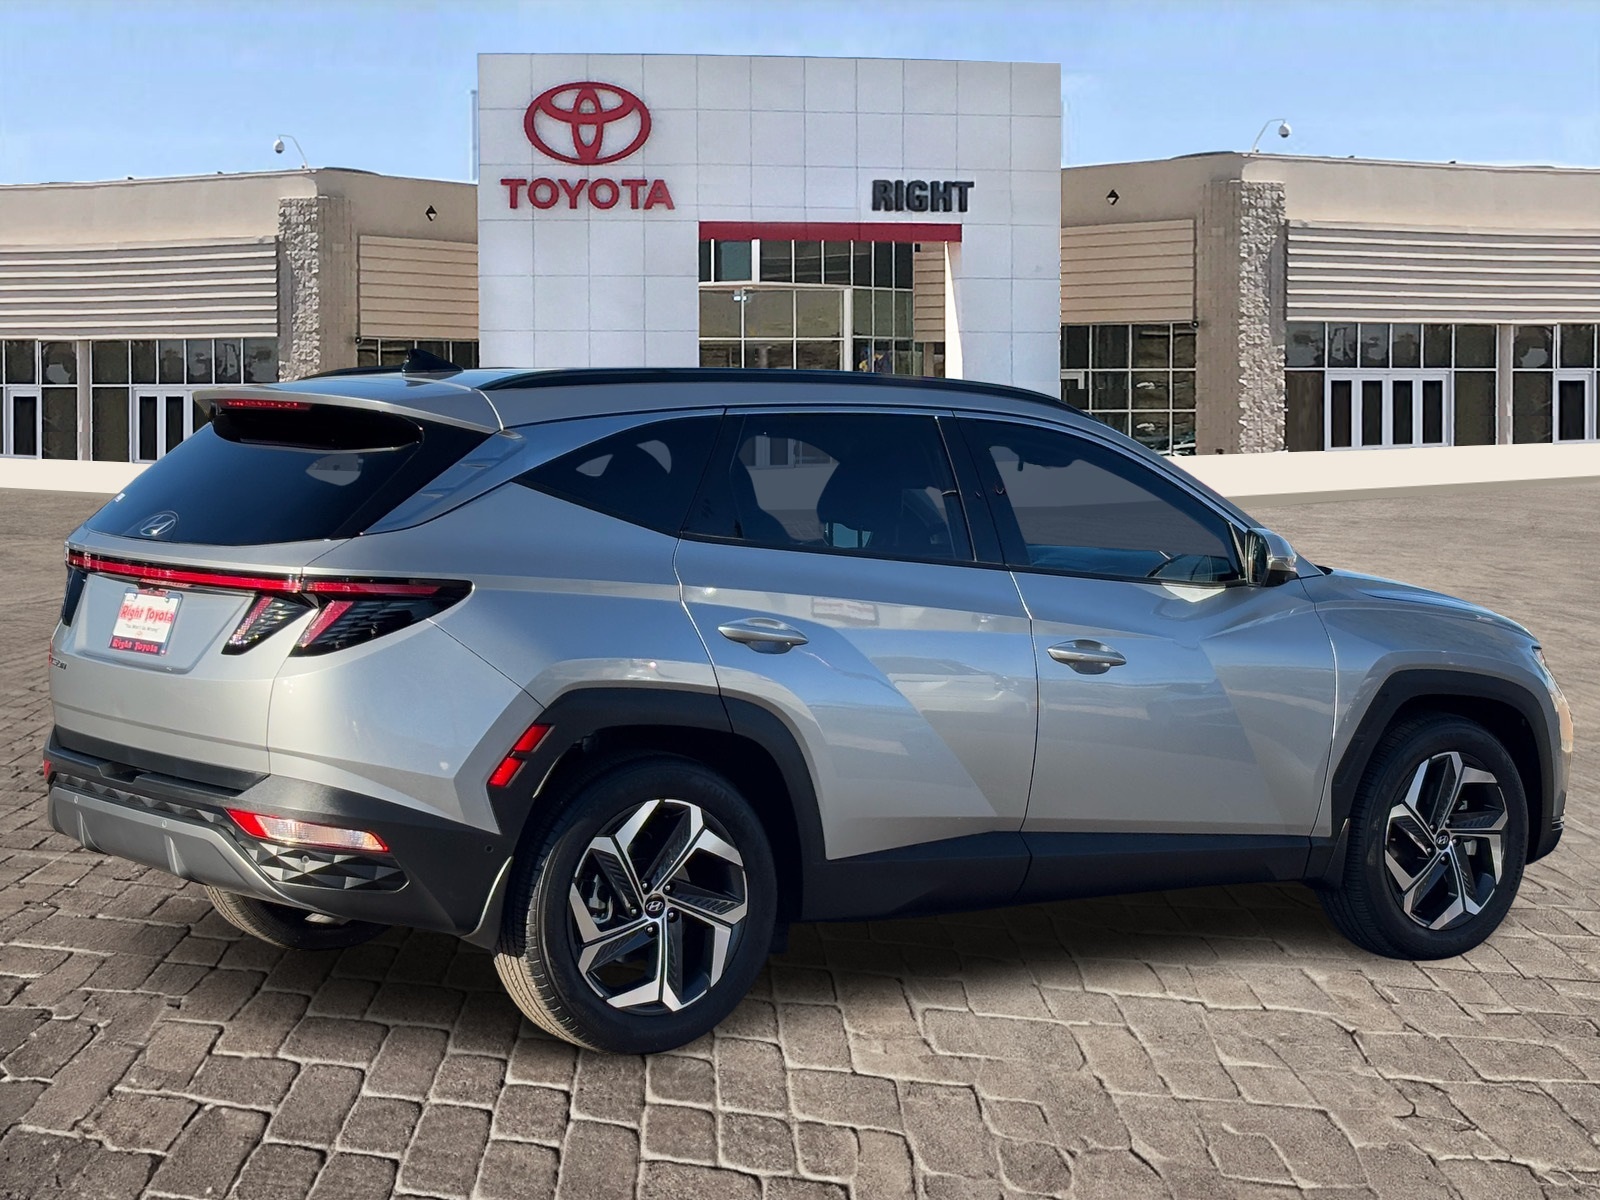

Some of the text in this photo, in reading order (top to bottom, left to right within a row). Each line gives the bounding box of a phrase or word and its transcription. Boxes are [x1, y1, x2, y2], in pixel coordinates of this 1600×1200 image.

[500, 178, 676, 210] TOYOTA
[871, 179, 975, 212] RIGHT
[120, 604, 175, 623] Right Toyota
[112, 639, 158, 653] Right Toyota
